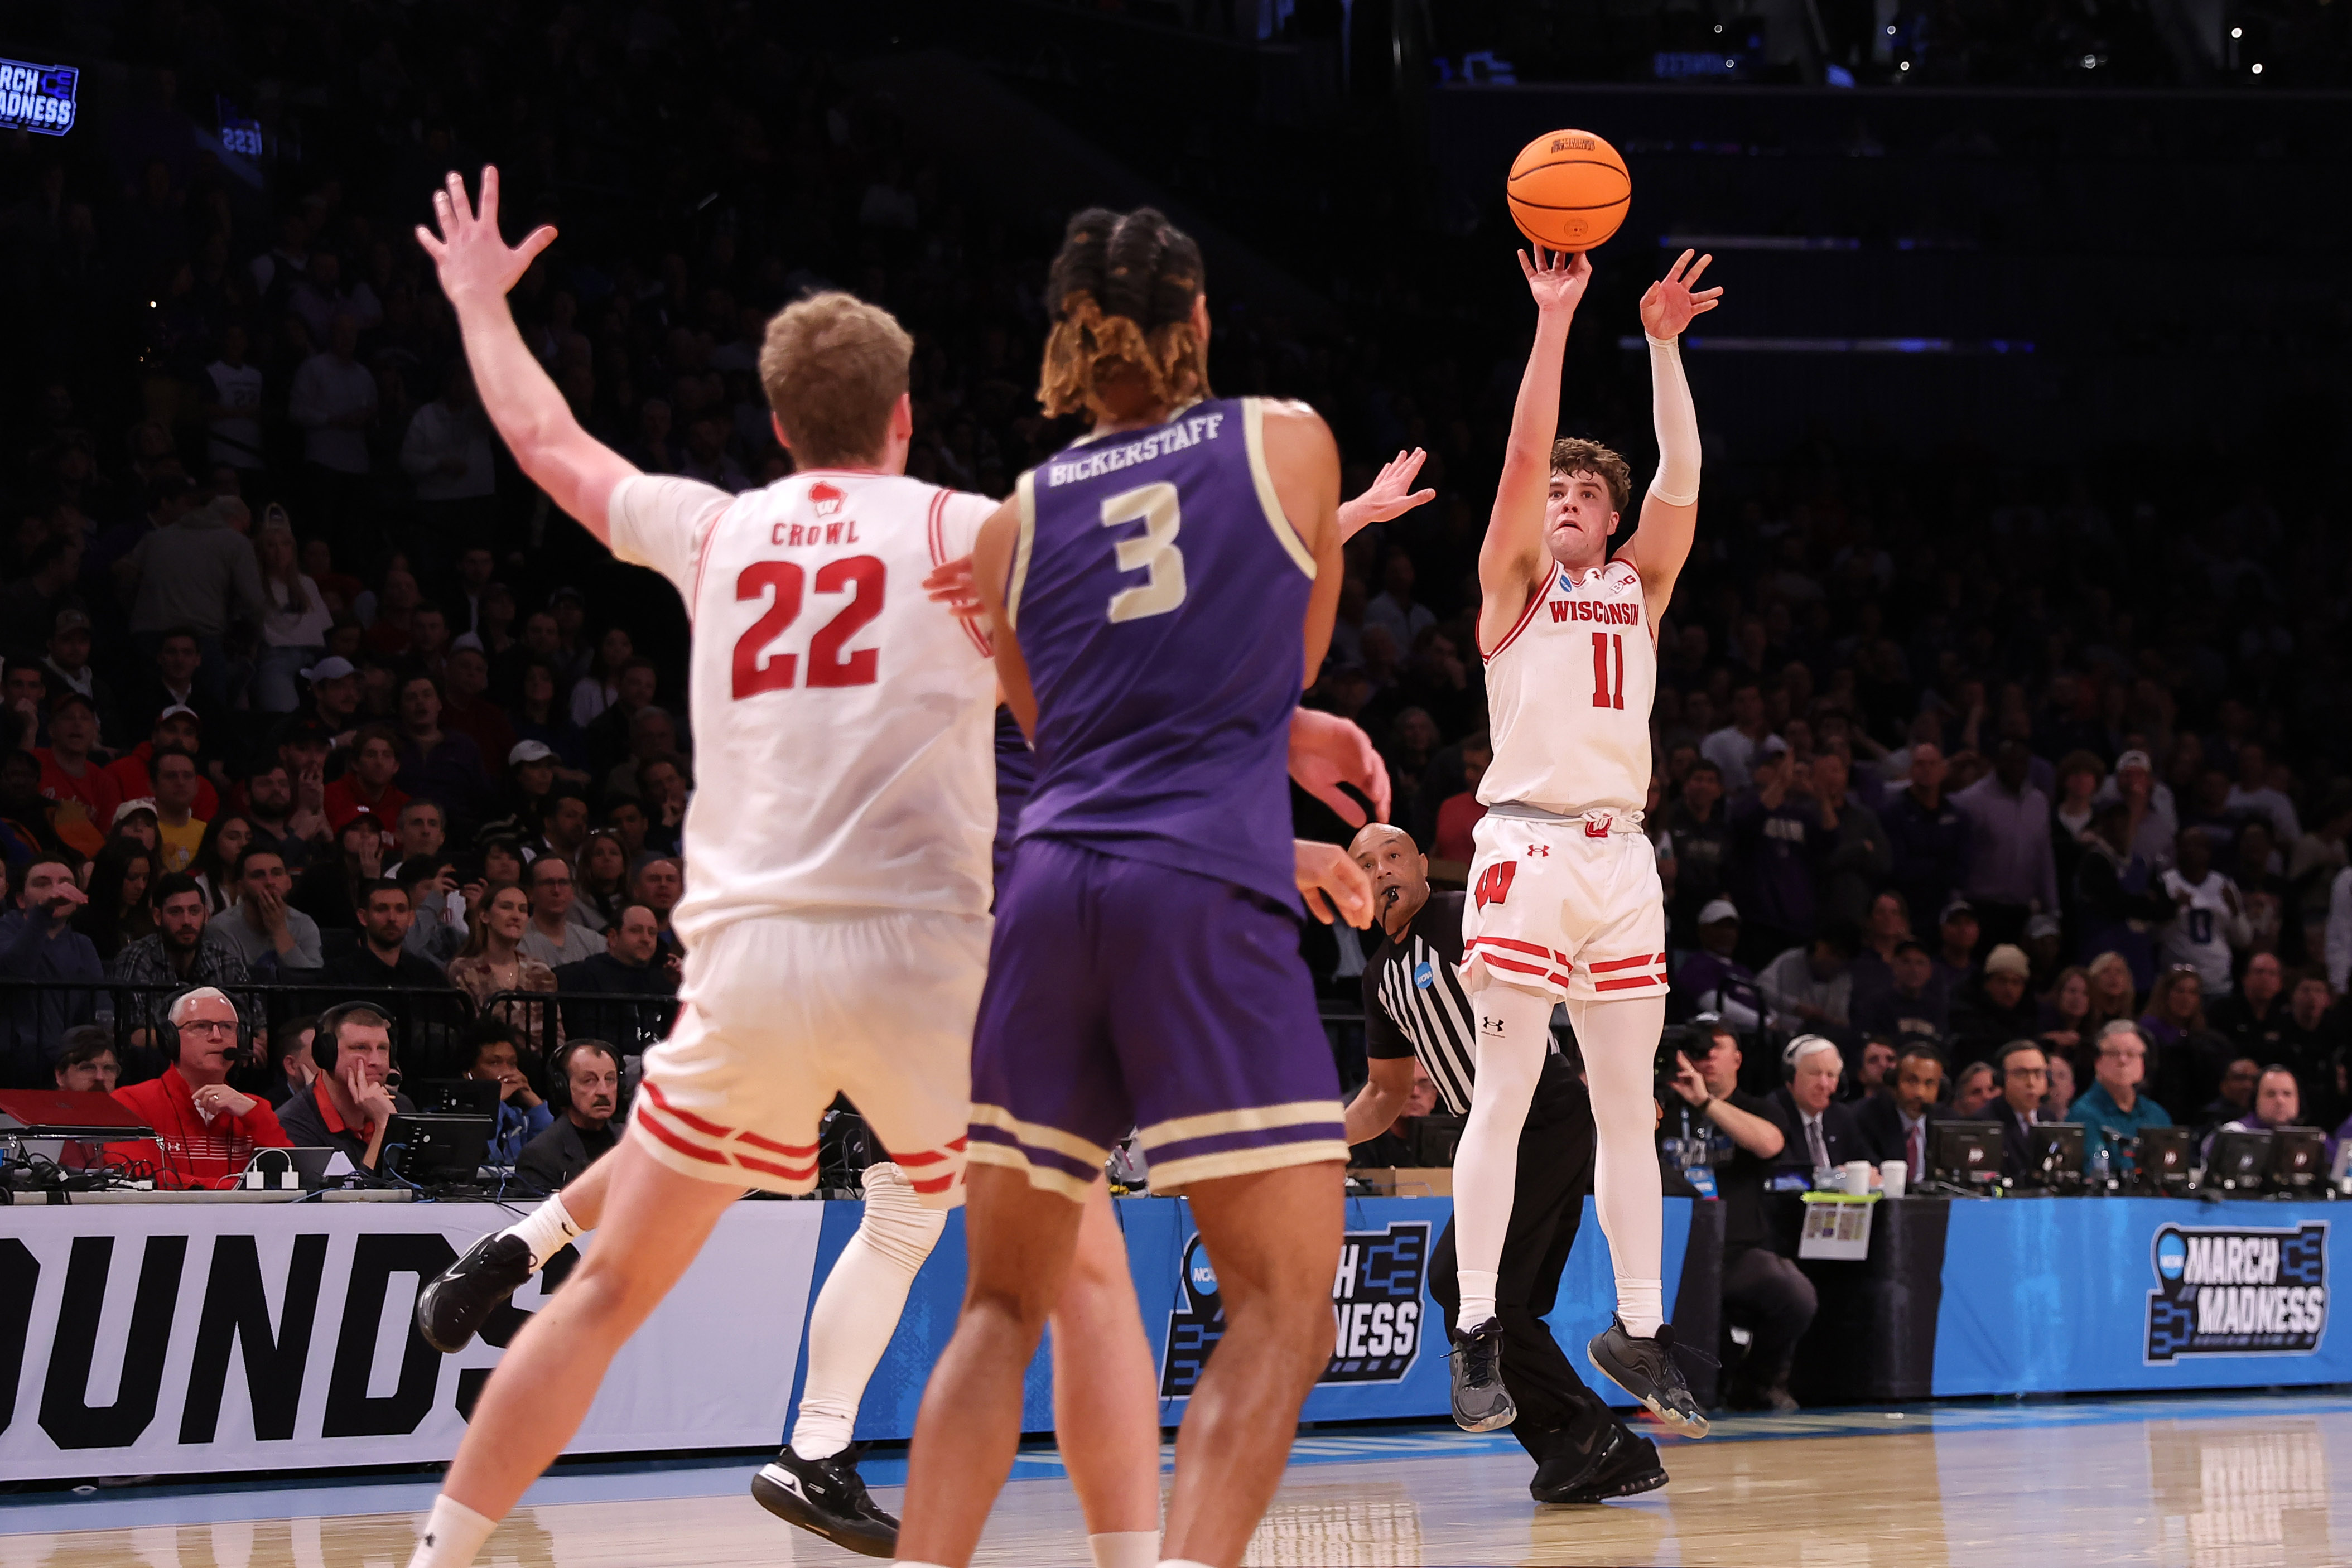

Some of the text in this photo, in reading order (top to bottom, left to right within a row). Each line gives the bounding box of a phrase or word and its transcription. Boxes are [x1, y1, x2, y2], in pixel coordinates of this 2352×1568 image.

[0, 65, 39, 94] RCH
[1049, 412, 1224, 488] BICKERSTAFF
[772, 520, 860, 546] CROWL
[1100, 481, 1187, 624] 3
[732, 554, 888, 701] 22
[1549, 600, 1639, 626] WISCONSIN
[1592, 631, 1624, 710] 11
[1474, 861, 1517, 914] W
[2190, 908, 2212, 944] 0
[2183, 1236, 2280, 1285] MARCH
[1332, 1301, 1419, 1358] NESS
[2197, 1285, 2325, 1334] MADNESS
